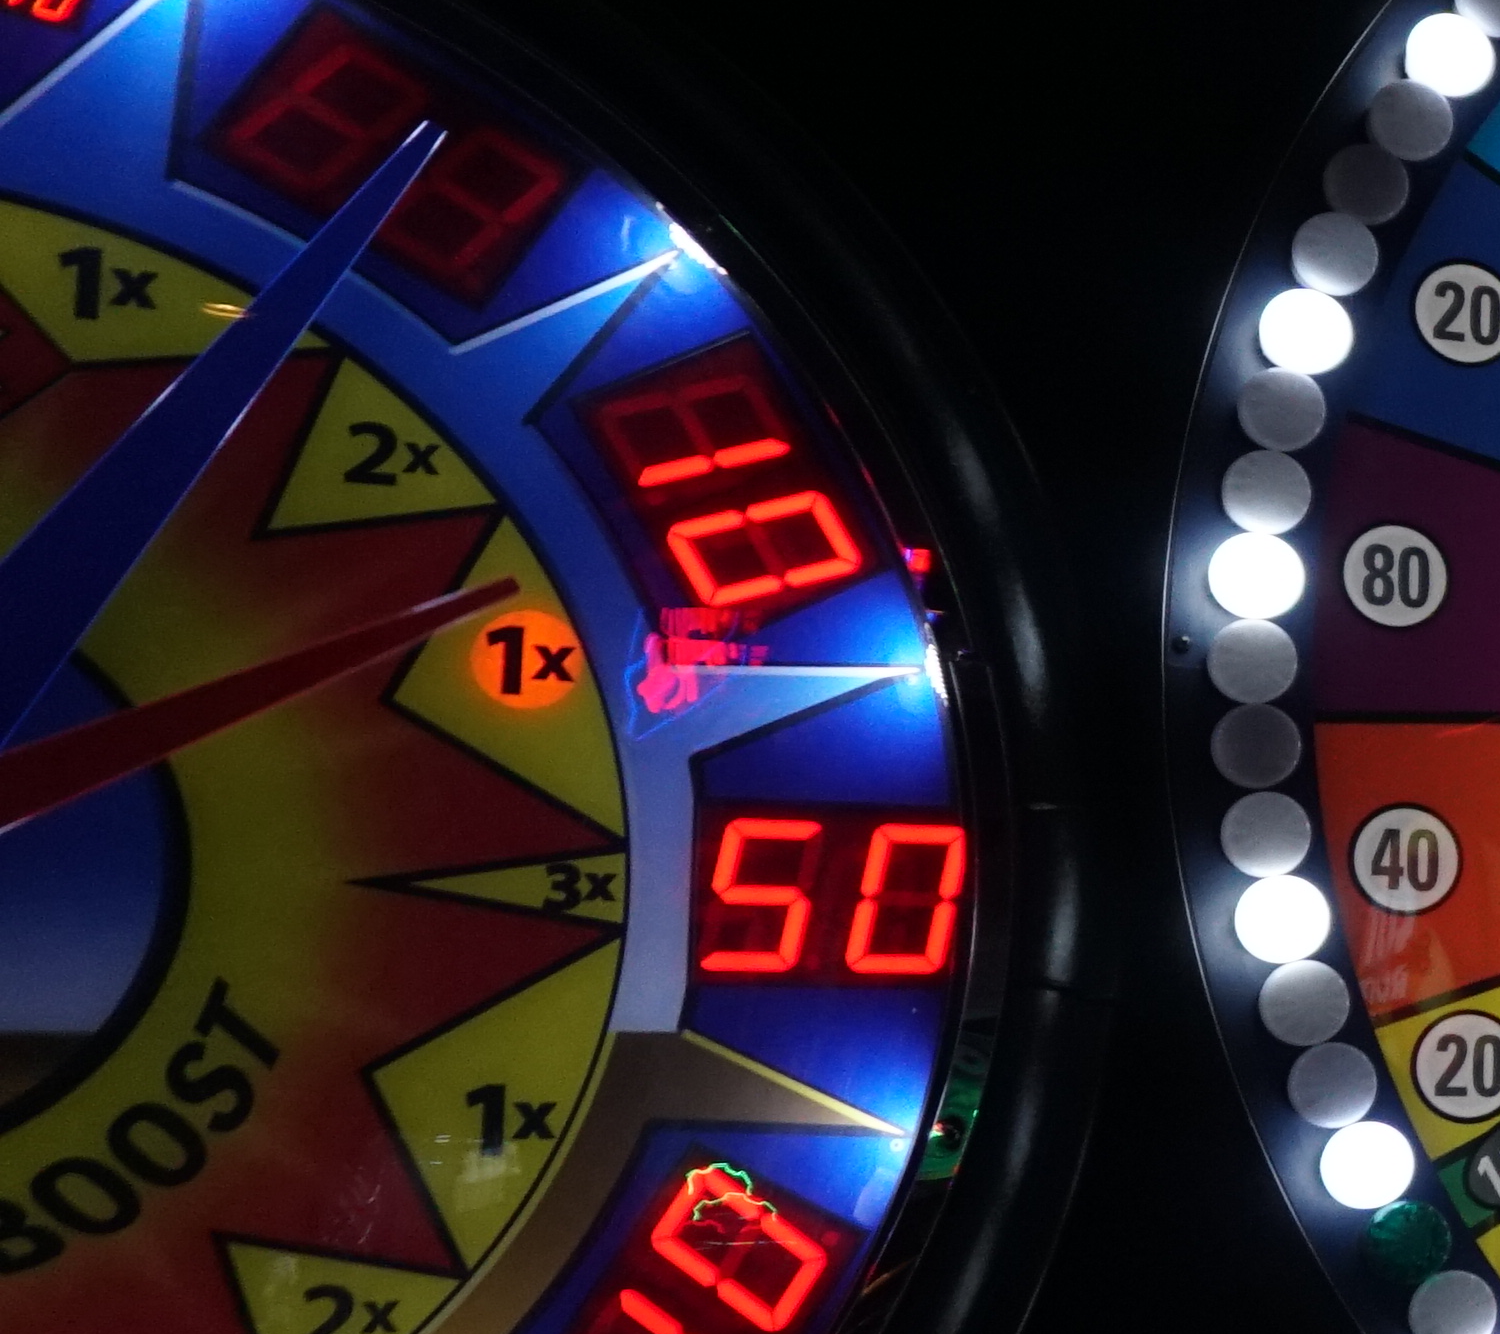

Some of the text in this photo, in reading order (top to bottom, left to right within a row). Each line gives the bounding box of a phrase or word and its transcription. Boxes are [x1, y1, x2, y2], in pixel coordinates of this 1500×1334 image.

[57, 245, 157, 321] 1x
[1433, 281, 1500, 345] 20
[342, 421, 442, 486] 2x
[638, 439, 863, 606] 10
[1363, 544, 1430, 608] 80
[485, 626, 577, 696] 1x
[543, 862, 618, 915] 3x
[1371, 828, 1439, 892] 40
[701, 817, 967, 975] 50
[466, 1084, 556, 1158] 1x
